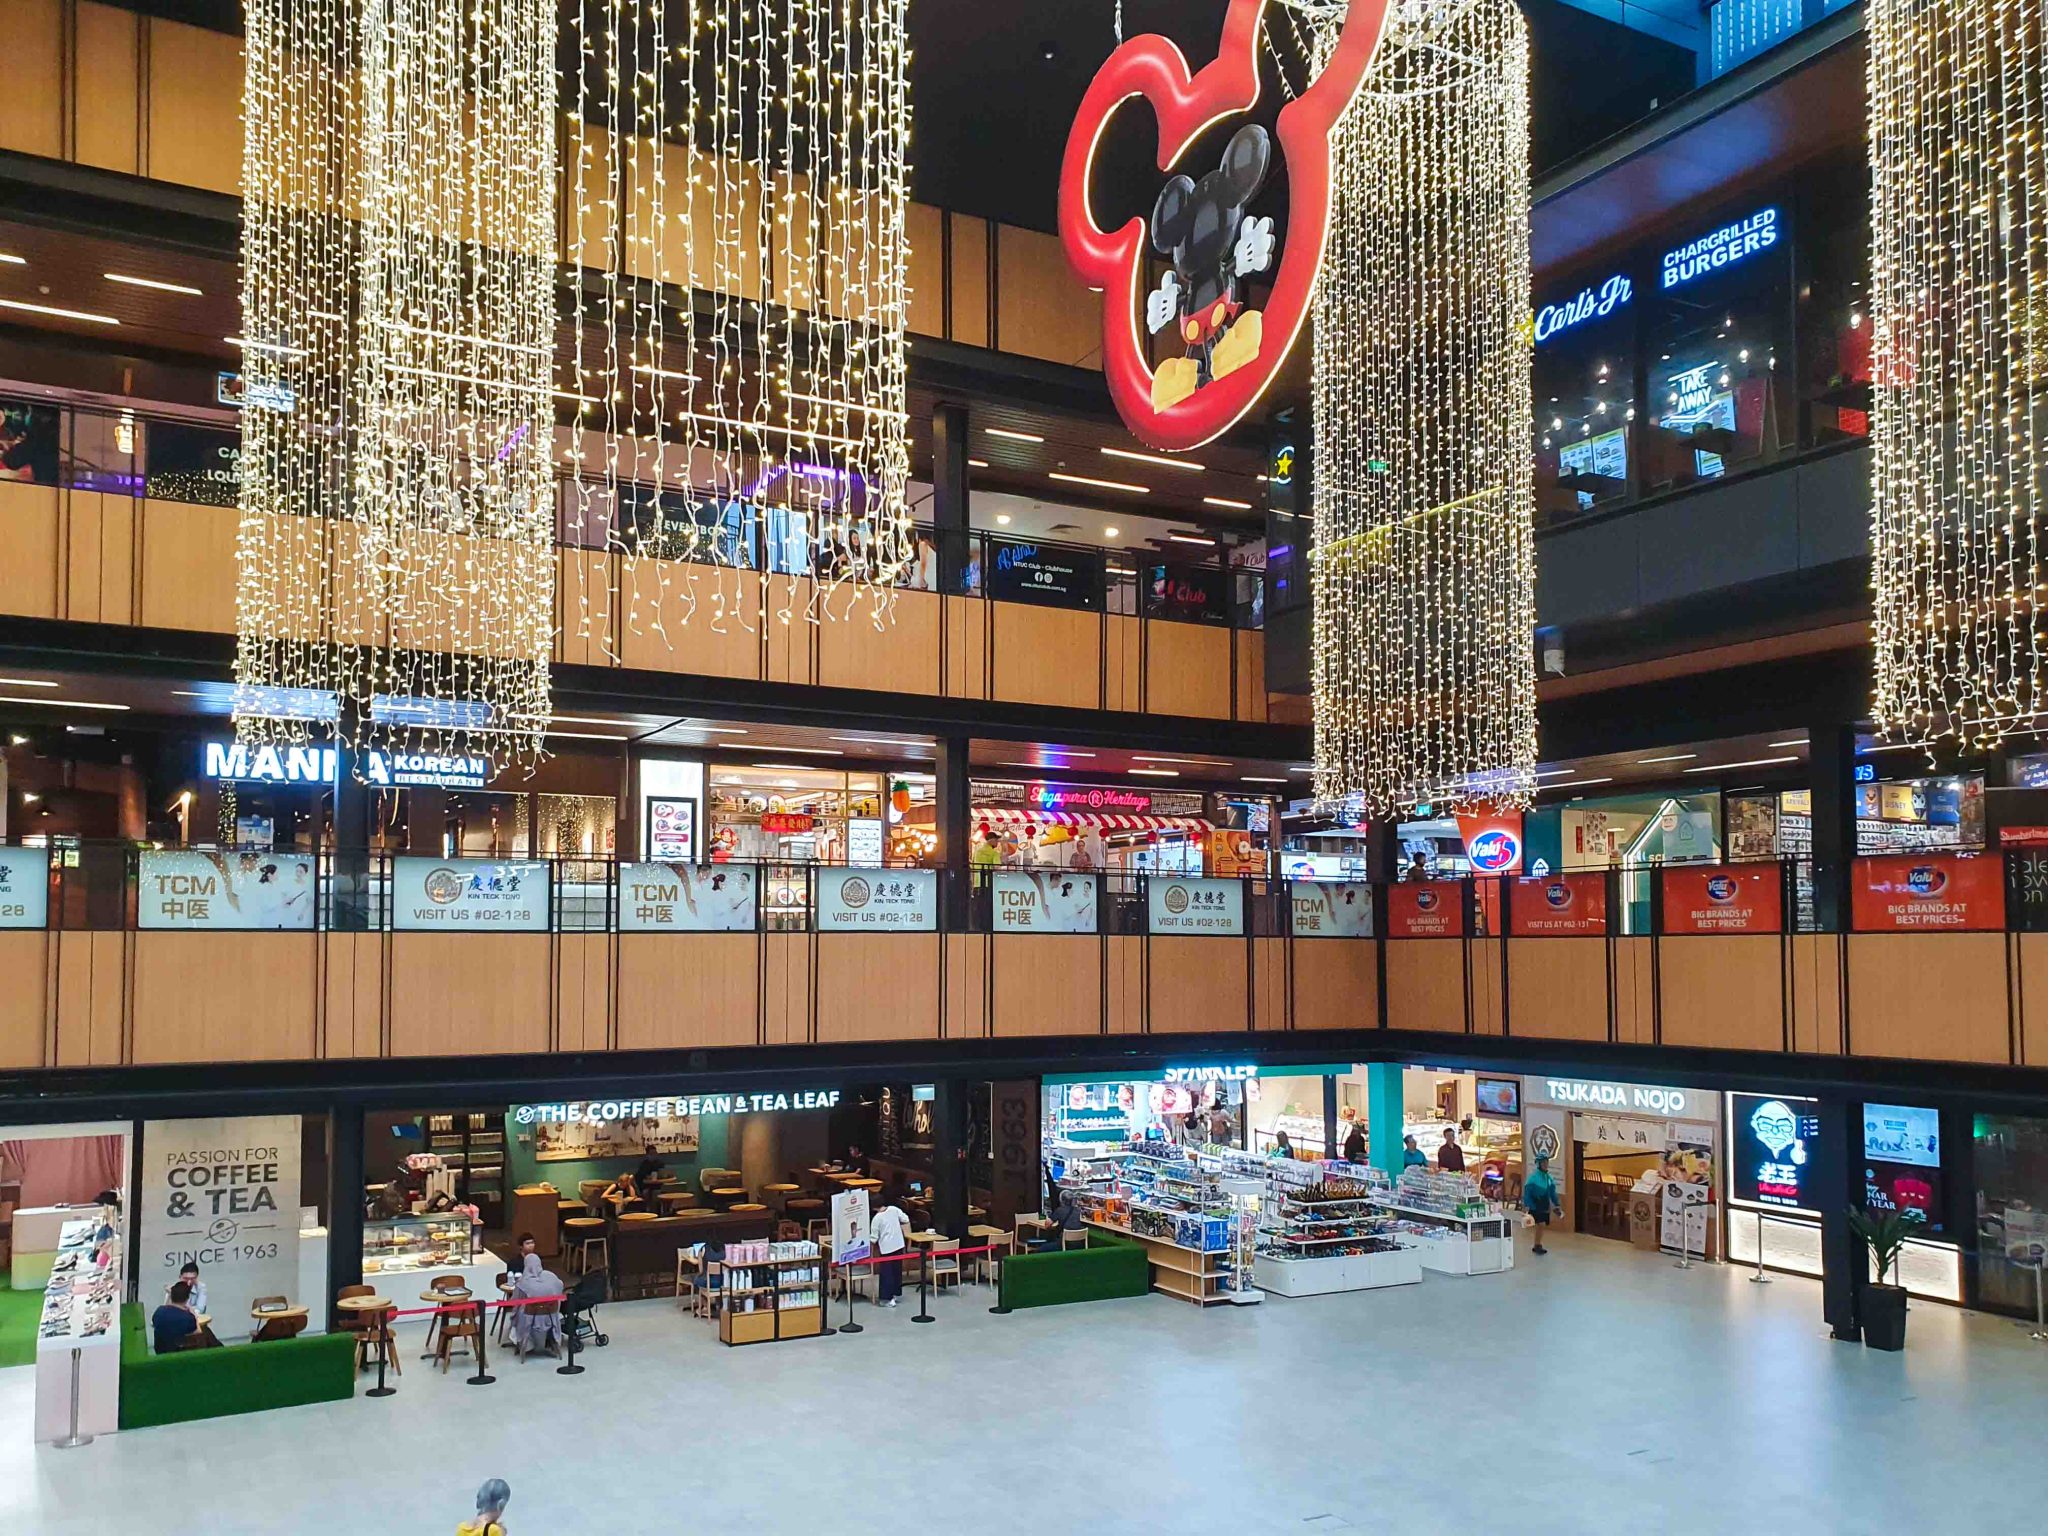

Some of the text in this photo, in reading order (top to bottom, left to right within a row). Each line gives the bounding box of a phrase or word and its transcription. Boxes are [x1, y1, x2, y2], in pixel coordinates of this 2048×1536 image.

[1664, 209, 1775, 267] CHARGRILLED
[1664, 225, 1776, 288] BURGERS
[1534, 275, 1632, 341] Carl's Jr
[1678, 369, 1709, 394] TAKE
[1677, 385, 1712, 413] AWAY
[1028, 562, 1041, 570] Club
[1045, 564, 1073, 574] Clubhouse
[395, 755, 484, 774] KOREAN
[398, 774, 483, 786] RESTAURANT
[1030, 786, 1151, 812] Singapura Heritage
[155, 875, 216, 896] TCM
[630, 884, 678, 902] TCM
[998, 890, 1036, 906] TCM
[1292, 898, 1324, 913] TCM
[162, 898, 209, 920] 中医
[413, 909, 531, 921] VISIT US #02-128
[636, 904, 673, 923] 中医
[832, 912, 923, 923] VISIT US #02-128
[1002, 908, 1032, 926] 中医
[1691, 909, 1753, 919] BIG BRANDS AT
[1888, 903, 1967, 914] BIG BRANDS AT
[1158, 917, 1232, 927] VISIT US #02-128
[1296, 915, 1321, 930] 中医
[1441, 917, 1449, 925] AT
[1527, 921, 1543, 929] VISIT
[1544, 921, 1553, 929] US
[1697, 919, 1747, 928] BEST PRICES
[1896, 914, 1958, 925] BEST PRICES
[1425, 925, 1445, 933] PRICES
[537, 1090, 840, 1122] THE COFFEE BEAN & TEA LEAF
[1547, 1080, 1686, 1114] TSUKADA NOJO
[167, 1147, 278, 1165] PASSION FOR
[167, 1163, 278, 1188] COFFEE
[1757, 1161, 1797, 1185] 老王
[166, 1186, 278, 1218] & TEA
[164, 1243, 278, 1267] SINCE 1963
